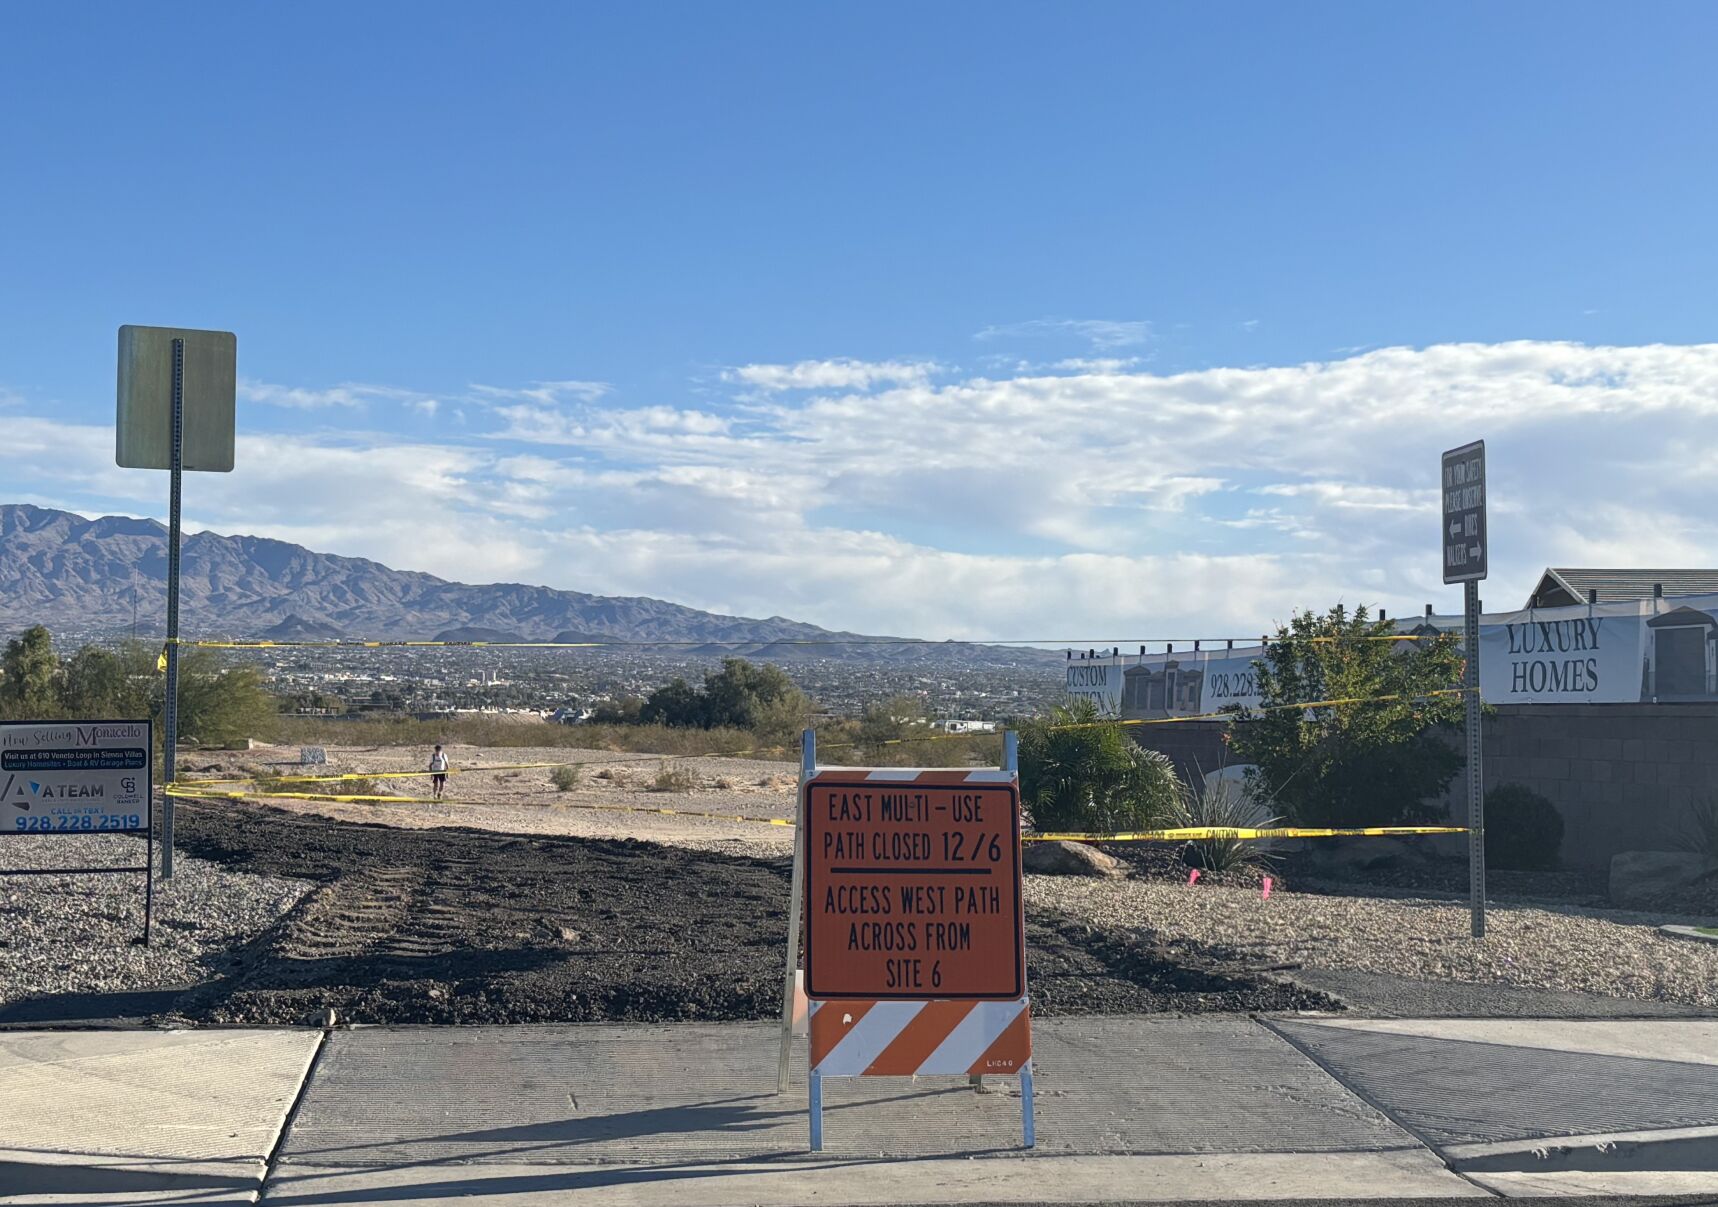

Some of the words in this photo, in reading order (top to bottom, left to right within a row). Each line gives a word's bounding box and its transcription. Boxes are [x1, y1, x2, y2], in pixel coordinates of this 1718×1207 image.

[1466, 458, 1482, 482] SAFETY
[1445, 490, 1462, 513] PLEASE
[1505, 617, 1603, 654] LUXURY
[1067, 666, 1107, 687] CUSTOM
[1211, 673, 1261, 698] 928.228.
[1510, 658, 1599, 693] HOMES
[42, 784, 54, 798] A
[57, 784, 104, 798] TEAM
[829, 793, 872, 822] EAST
[16, 814, 140, 831] 928.228.2519
[1206, 829, 1239, 840] CAUTION
[824, 832, 865, 860] PATH
[873, 832, 931, 861] CLOSED
[942, 831, 1001, 862] 12/6
[825, 885, 891, 914] ACCESS
[900, 886, 945, 914] WEST
[955, 886, 1000, 914] PATH
[848, 922, 917, 950] ACROSS
[926, 922, 971, 951] FROM
[886, 959, 922, 988] SITE
[931, 960, 942, 988] 6
